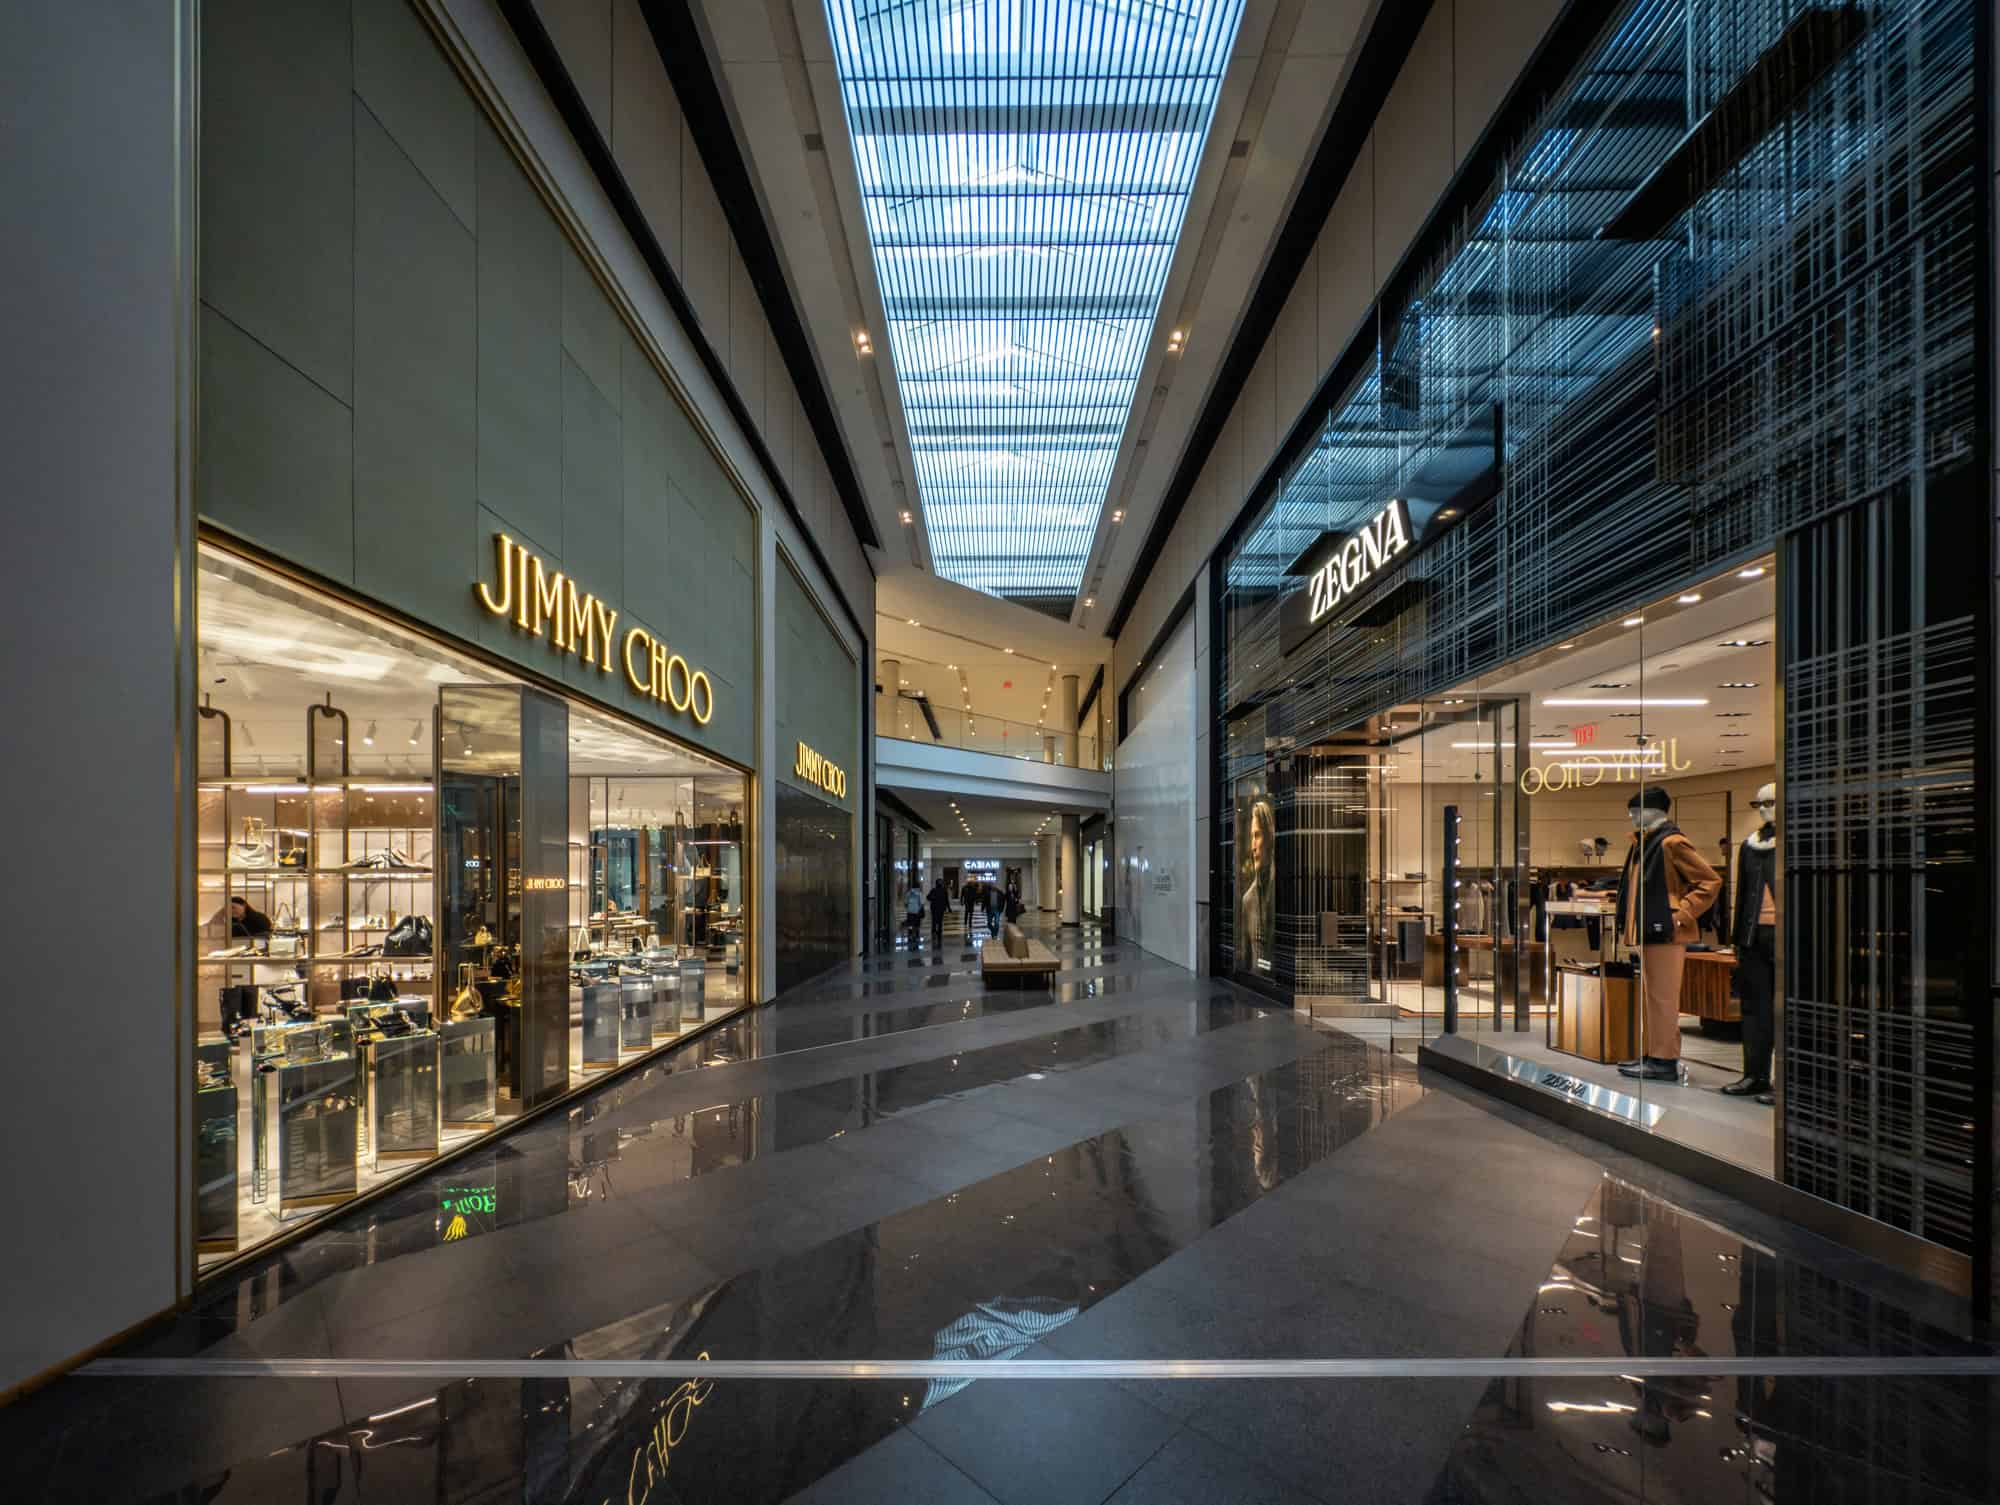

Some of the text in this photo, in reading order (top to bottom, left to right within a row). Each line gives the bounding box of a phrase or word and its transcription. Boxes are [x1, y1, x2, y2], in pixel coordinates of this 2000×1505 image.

[1309, 499, 1408, 623] ZEGNA
[475, 533, 713, 725] JIMMY CHOO
[795, 741, 846, 798] JIMMY CHOO
